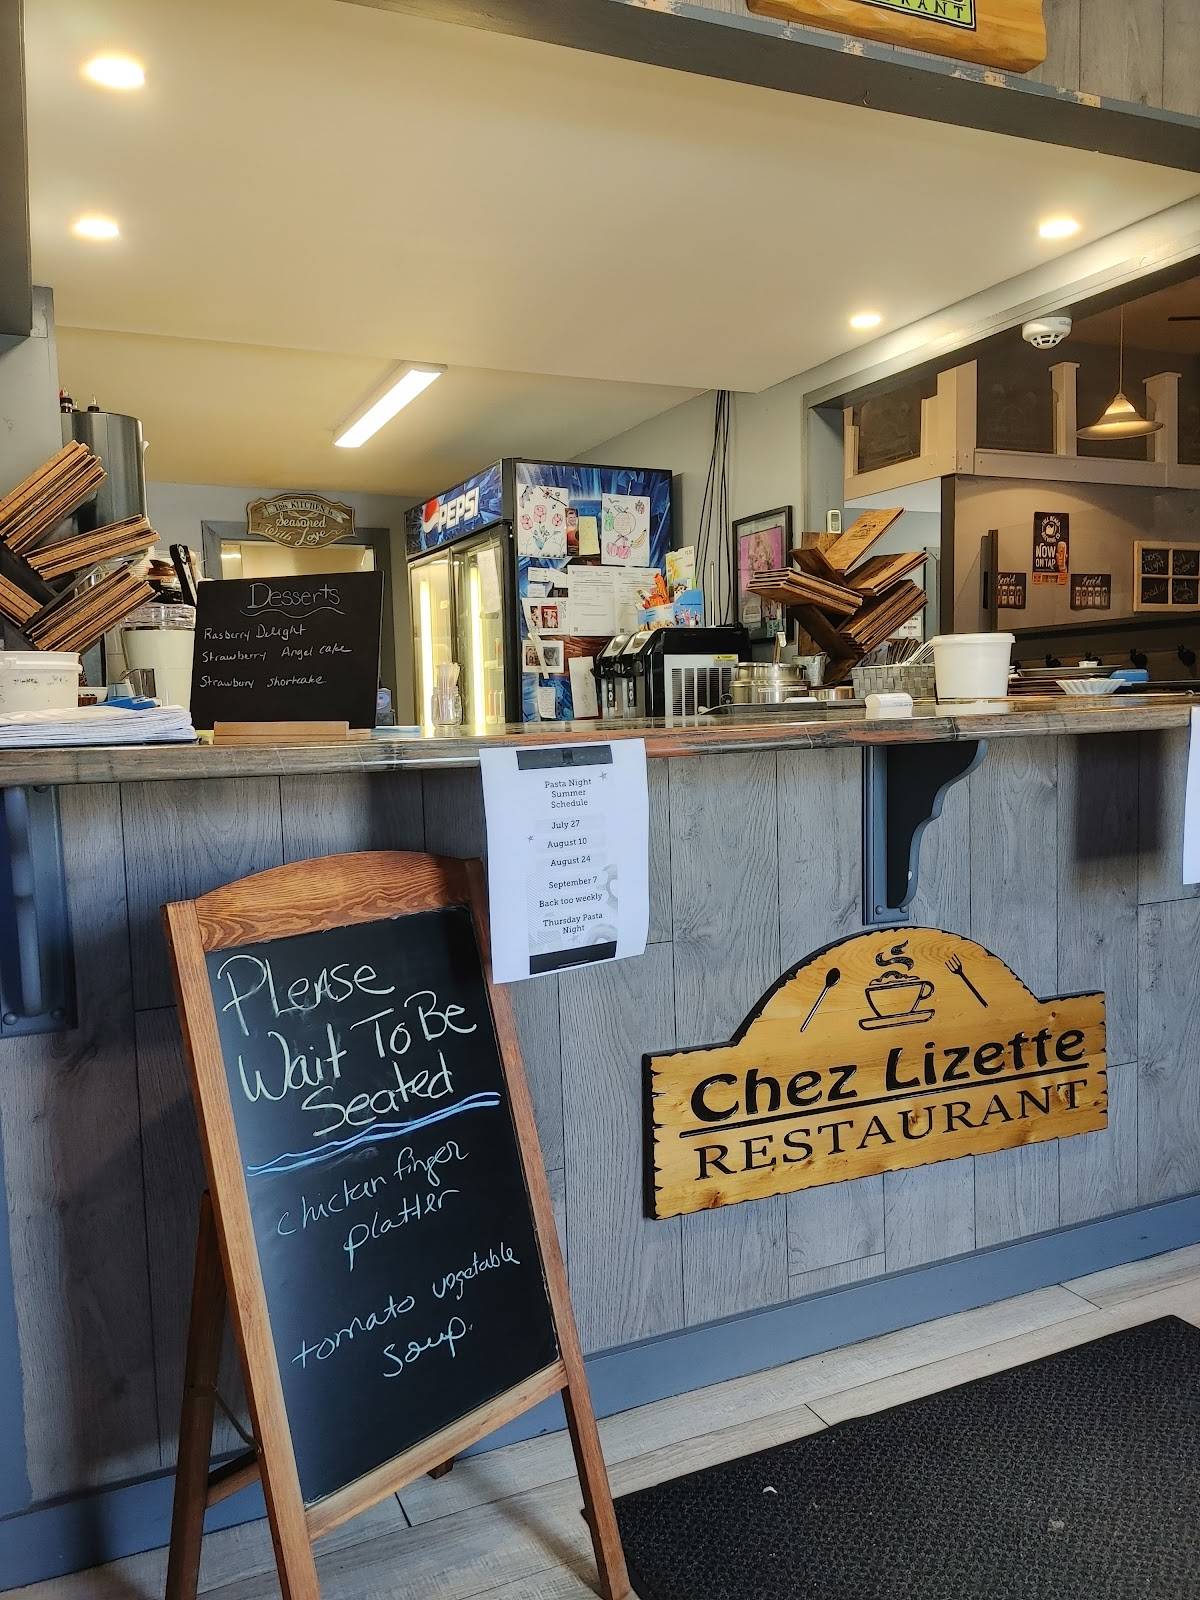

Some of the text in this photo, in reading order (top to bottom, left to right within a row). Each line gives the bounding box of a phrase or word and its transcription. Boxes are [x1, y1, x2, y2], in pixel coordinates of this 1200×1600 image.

[438, 486, 480, 533] PEPSI
[276, 512, 327, 528] Seasoned
[295, 527, 335, 545] Love
[1035, 543, 1056, 558] NOW
[1035, 559, 1056, 570] ON TAP
[247, 583, 340, 608] Desserts
[256, 624, 307, 640] Delight
[201, 651, 266, 663] Strawberry
[281, 647, 312, 660] Angel
[544, 778, 592, 788] Pasta Night
[551, 789, 586, 798] Summer
[551, 799, 588, 809] Schedule
[551, 820, 580, 830] July 27
[547, 837, 587, 849] August 10
[550, 855, 591, 867] August 24
[548, 875, 598, 889] September 7
[539, 892, 603, 908] Back too weekly
[543, 912, 603, 927] Thursday Pasta
[562, 924, 585, 934] Night
[238, 990, 477, 1103] Wait To Be
[690, 1027, 1086, 1122] Chez Lizette
[301, 1049, 453, 1136] Seated
[694, 1078, 1088, 1181] RESTAURANT
[393, 1141, 470, 1187] finger
[291, 1295, 415, 1369] tomato
